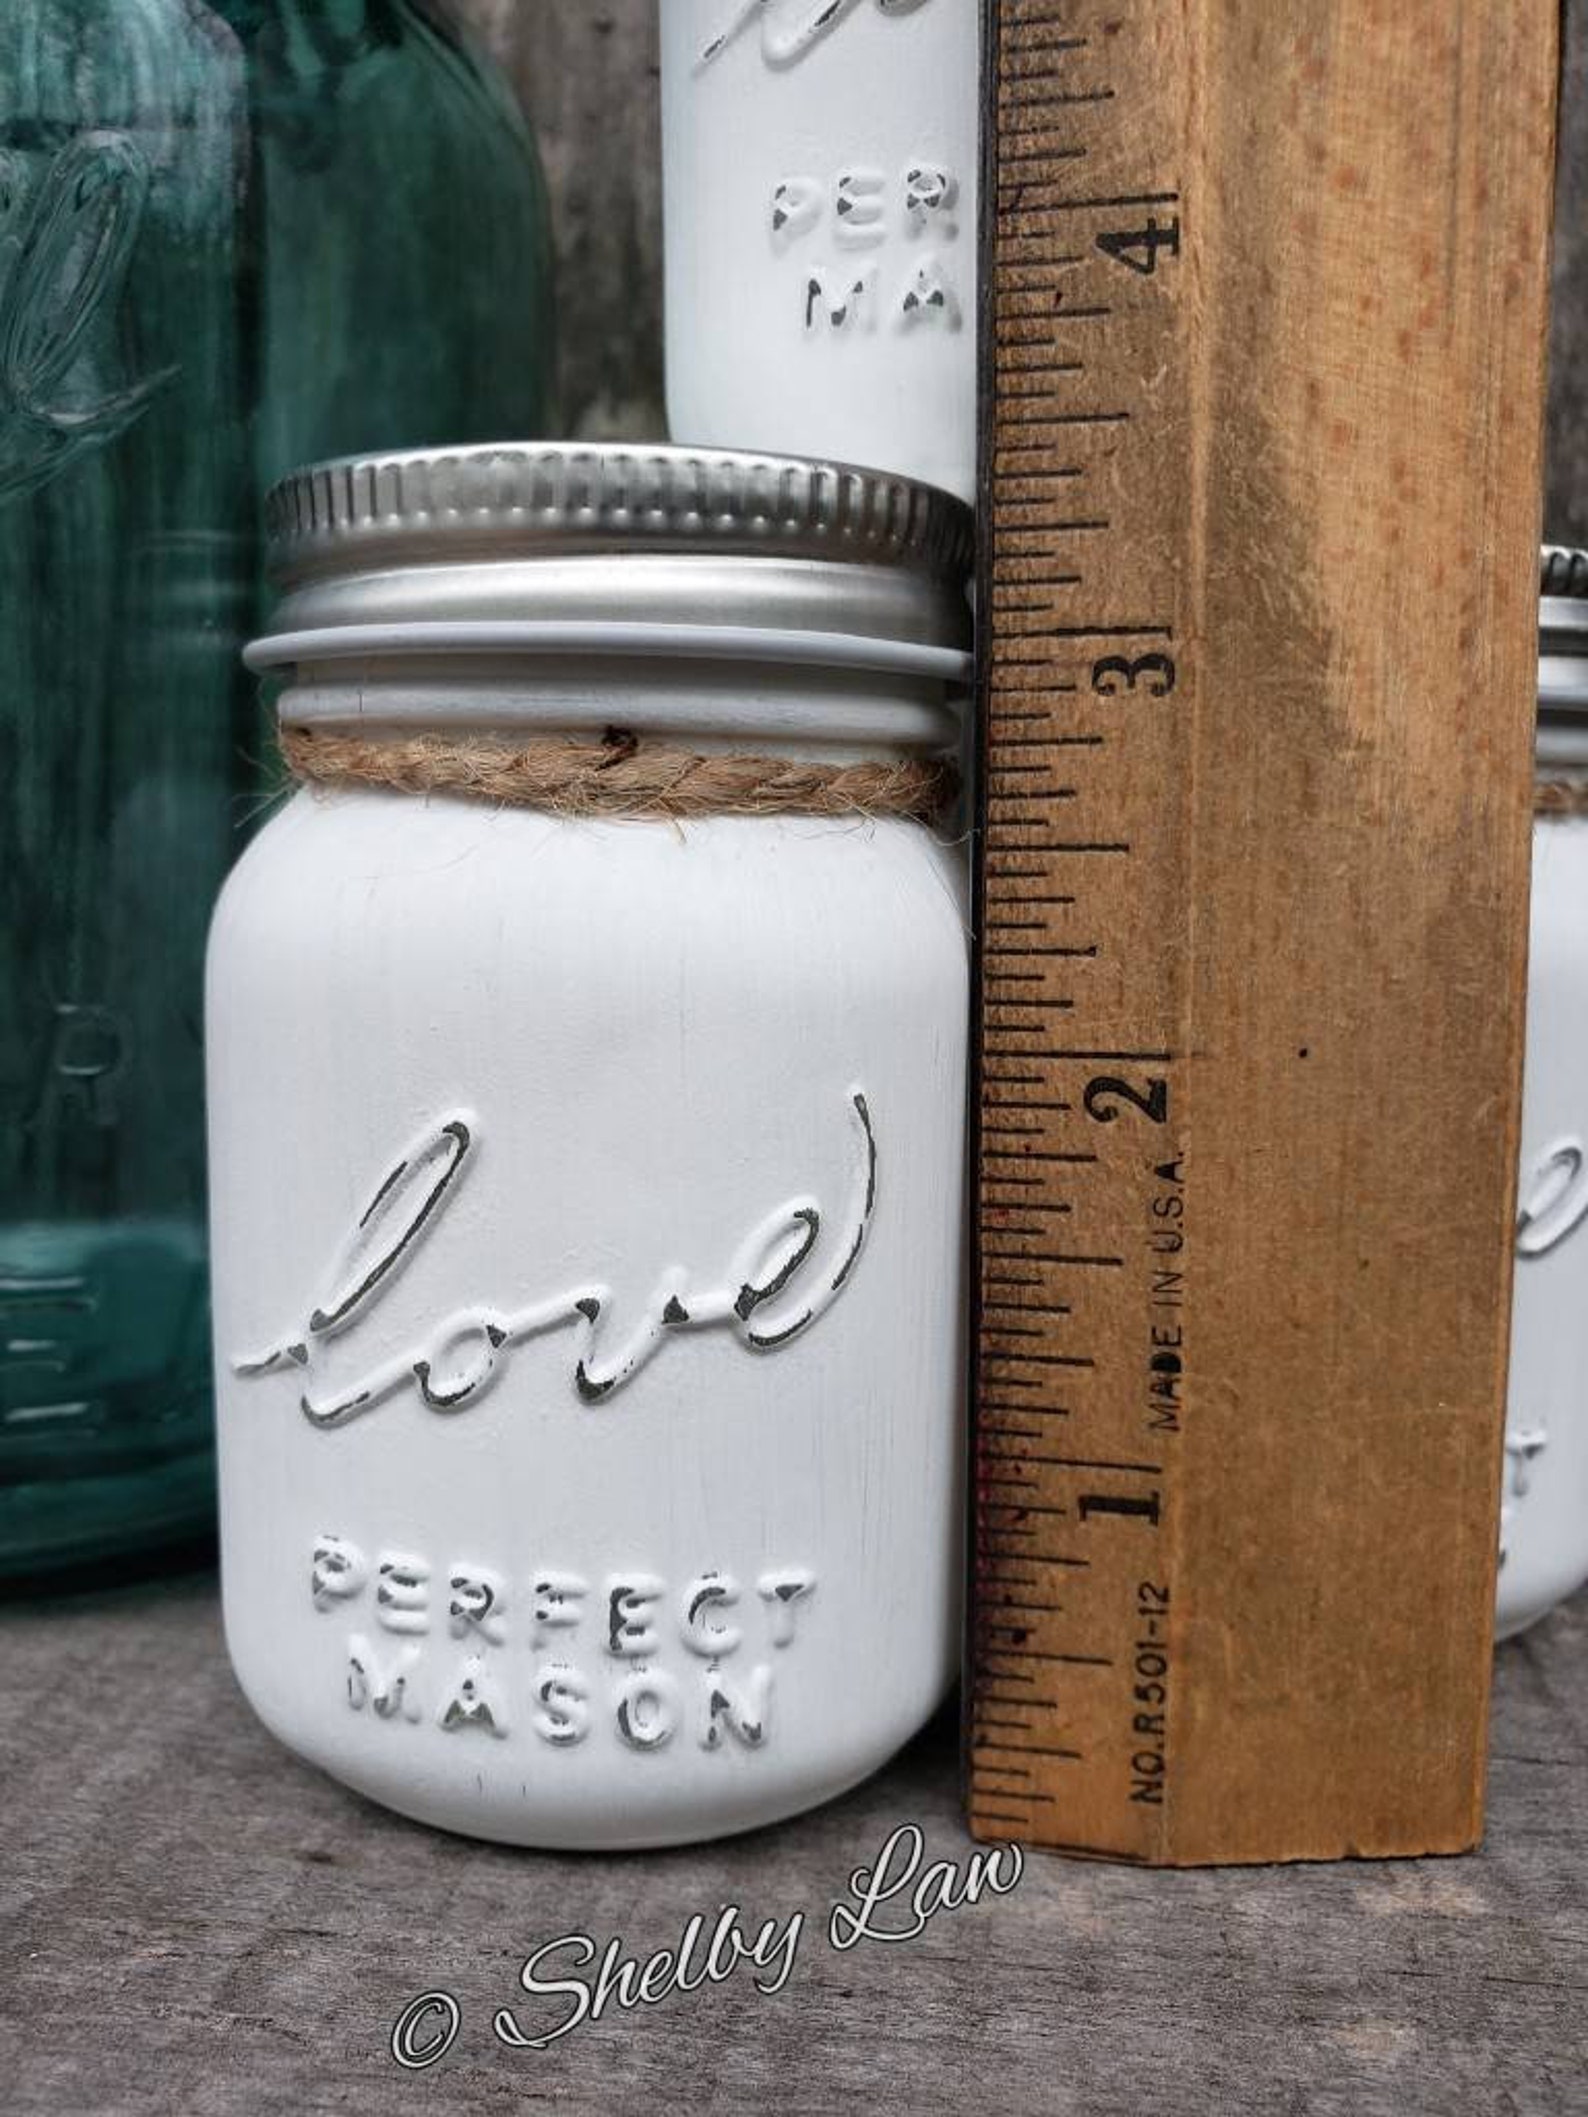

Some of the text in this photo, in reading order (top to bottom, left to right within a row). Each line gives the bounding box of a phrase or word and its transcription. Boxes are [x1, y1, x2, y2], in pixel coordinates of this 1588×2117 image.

[1095, 216, 1180, 275] 4
[1092, 653, 1175, 696] 3
[1083, 1075, 1167, 1123] 2
[229, 1083, 876, 1428] love
[1148, 1151, 1185, 1432] MADE IN U.S.A.
[1078, 1491, 1160, 1526] 1
[312, 1534, 816, 1657] PERFECT
[346, 1634, 775, 1752] MASON
